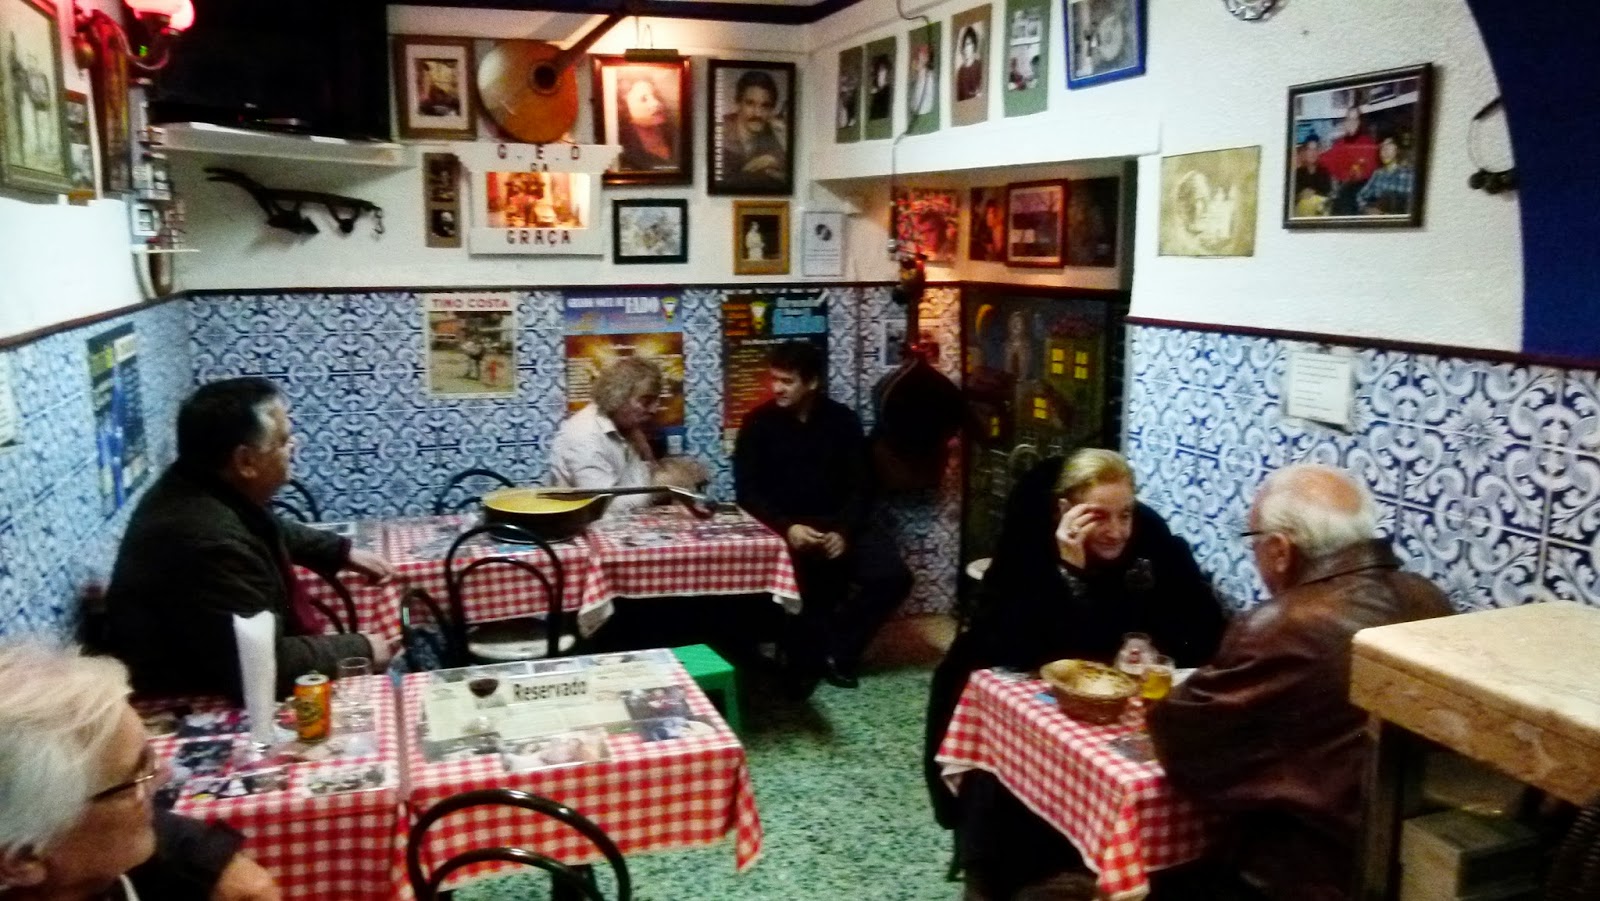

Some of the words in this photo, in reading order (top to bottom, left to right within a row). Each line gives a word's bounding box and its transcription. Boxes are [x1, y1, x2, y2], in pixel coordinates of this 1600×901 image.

[506, 229, 571, 247] GRAÇA
[468, 298, 509, 308] COSTA
[513, 679, 587, 701] Reservado
